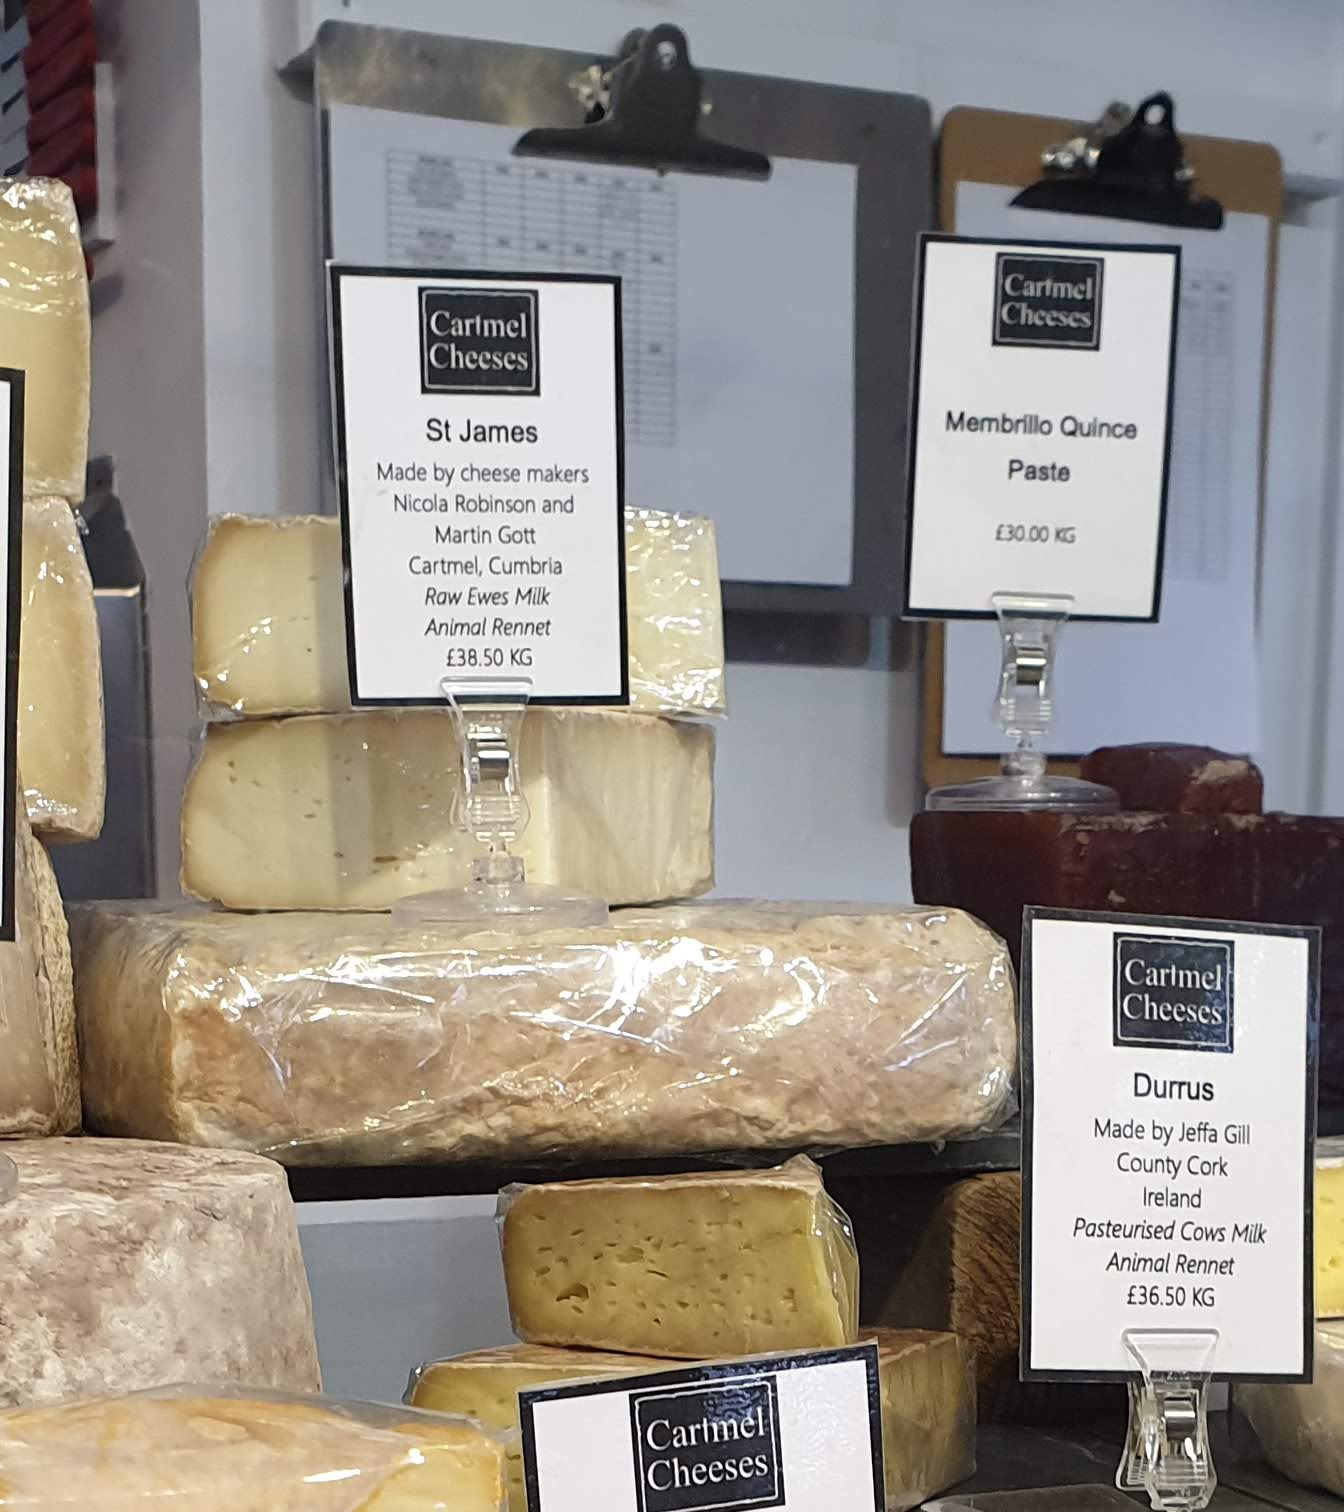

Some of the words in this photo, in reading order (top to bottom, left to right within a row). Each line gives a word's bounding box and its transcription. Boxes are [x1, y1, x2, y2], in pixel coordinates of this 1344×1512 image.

[1004, 273, 1094, 300] Cartmel
[430, 311, 527, 338] Cartmel
[1001, 303, 1092, 329] Cheeses
[429, 343, 529, 371] Cheeses
[426, 417, 452, 443] St
[459, 418, 538, 444] James
[945, 409, 1053, 436] Membrillo
[1059, 415, 1138, 440] Quince
[376, 461, 428, 482] Made
[432, 461, 456, 488] by
[460, 462, 521, 483] cheese
[526, 463, 590, 484] makers
[1007, 458, 1071, 483] Paste
[393, 492, 449, 513] Nicola
[455, 493, 536, 514] Robinson
[541, 494, 575, 514] and
[434, 524, 492, 545] Martin
[497, 524, 537, 545] Gott
[1054, 526, 1077, 545] KG
[408, 555, 483, 578] Cartmel,
[488, 555, 563, 576] Cumbria
[424, 586, 463, 606] Raw
[467, 586, 509, 606] Ewes
[514, 586, 551, 606] Milk
[424, 616, 487, 637] Animal
[491, 617, 552, 637] Rennet
[445, 647, 504, 668] £38.50
[509, 647, 533, 667] KG
[1124, 959, 1222, 991] Cartmel
[1122, 993, 1222, 1025] Cheeses
[1133, 1071, 1215, 1102] Durrus
[1094, 1117, 1146, 1140] Made
[1151, 1119, 1174, 1147] by
[1178, 1121, 1218, 1144] Jeffa
[1223, 1124, 1250, 1145] Gill
[1116, 1151, 1183, 1181] County
[1186, 1154, 1228, 1177] Cork
[1143, 1186, 1202, 1209] Ireland
[1072, 1217, 1177, 1241] Pasteurised
[1180, 1220, 1227, 1243] Cows
[1231, 1222, 1267, 1244] Milk
[1105, 1251, 1171, 1274] Animal
[1174, 1253, 1235, 1276] Rennet
[1126, 1284, 1186, 1307] £36.50
[1192, 1286, 1215, 1308] KG
[646, 1408, 766, 1451] Cartmel
[646, 1452, 768, 1492] Cheeses
